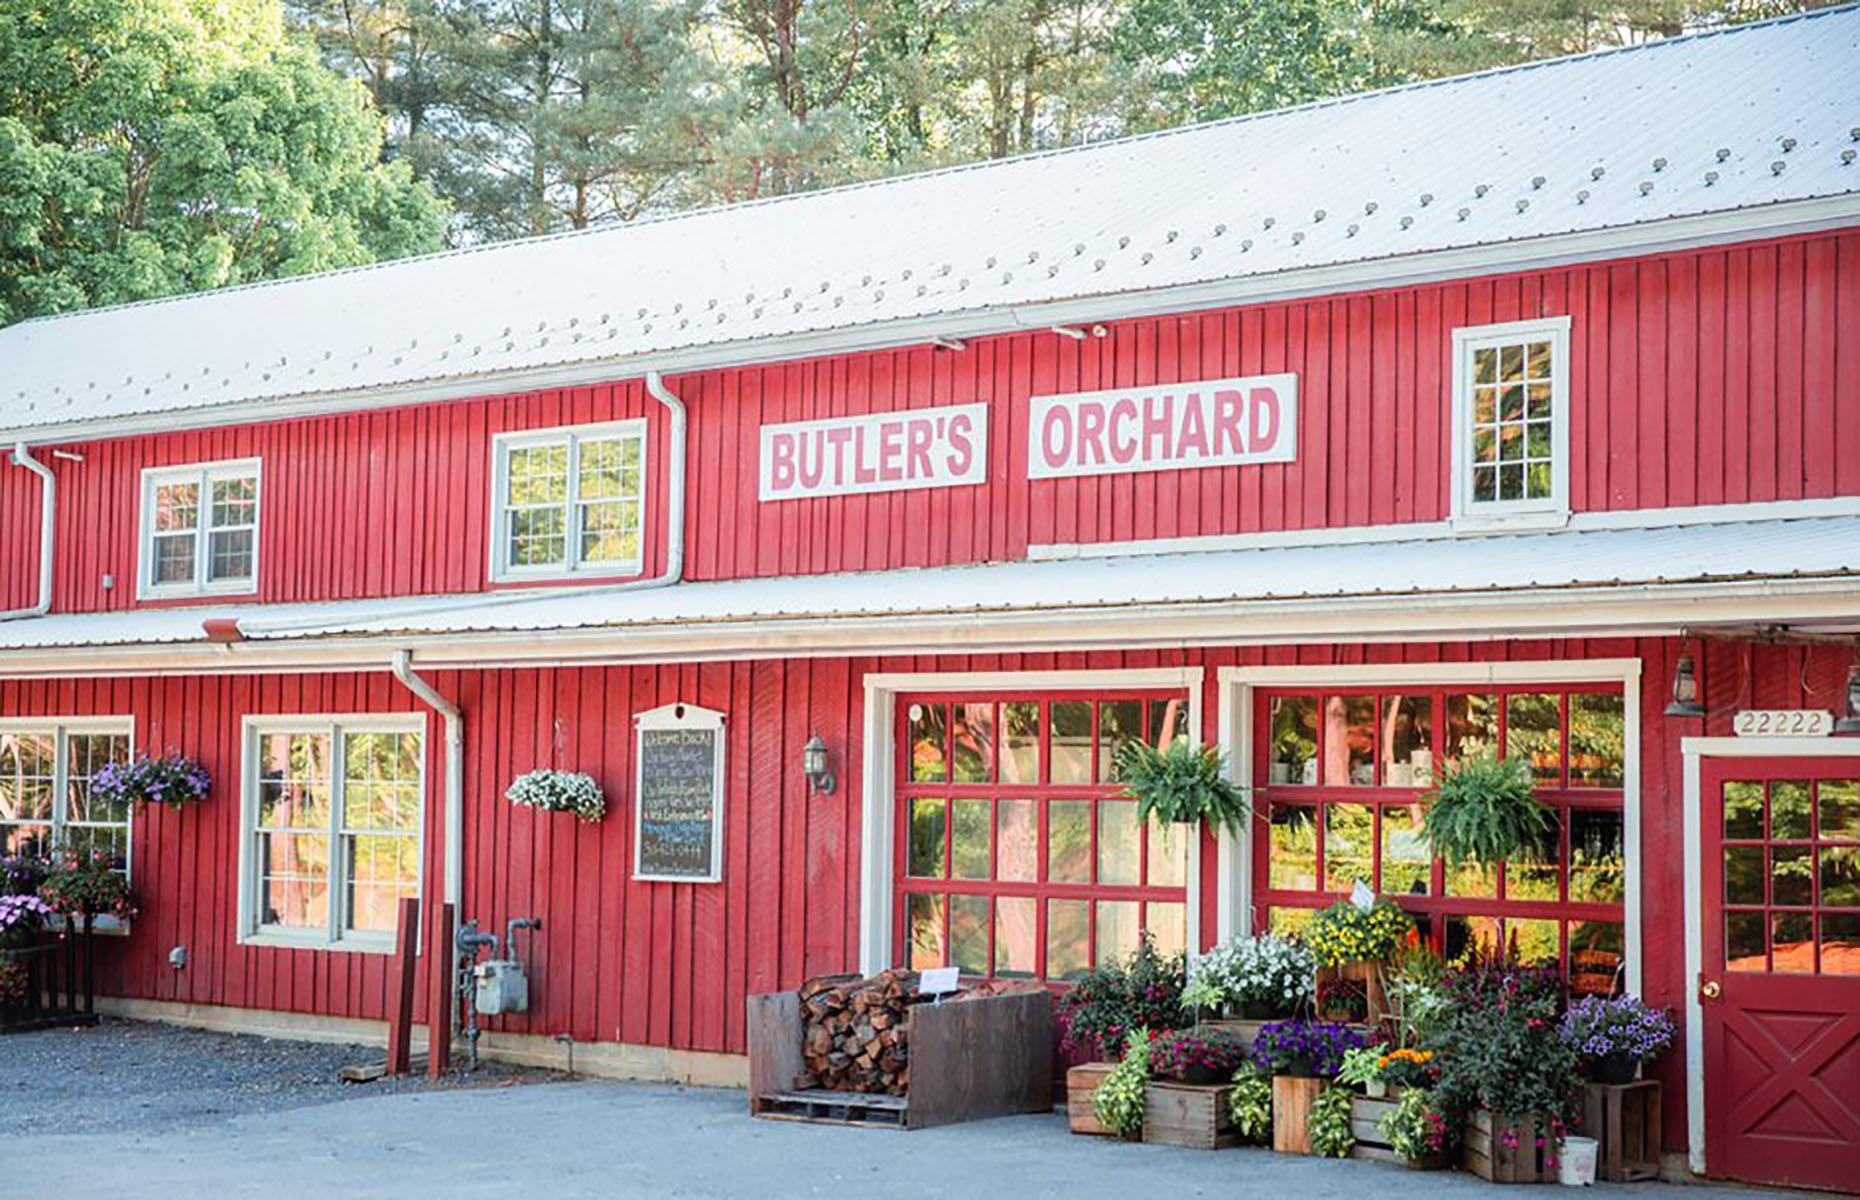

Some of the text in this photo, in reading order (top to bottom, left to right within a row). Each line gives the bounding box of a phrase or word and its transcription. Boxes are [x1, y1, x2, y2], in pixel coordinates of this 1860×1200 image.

[771, 387, 1280, 490] BUTLER'S ORCHARD
[1741, 713, 1821, 733] 22222
